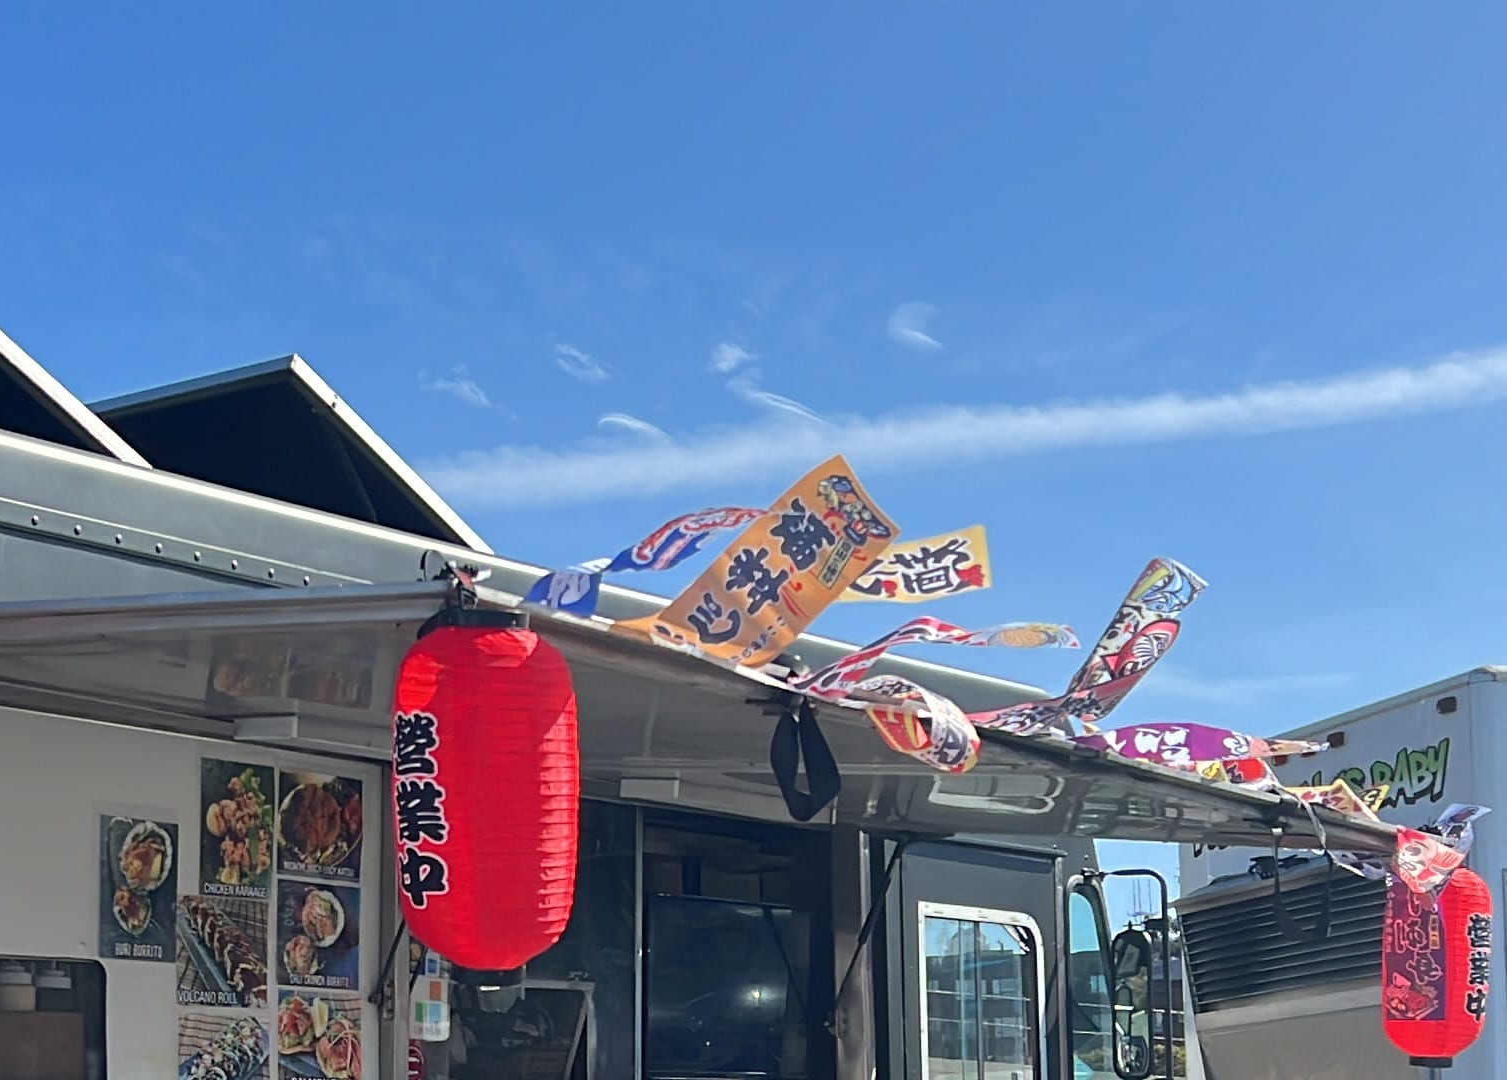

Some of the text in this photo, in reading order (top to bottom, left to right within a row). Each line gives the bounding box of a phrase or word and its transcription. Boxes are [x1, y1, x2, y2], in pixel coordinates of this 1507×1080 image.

[1372, 737, 1451, 808] BABY
[203, 882, 234, 895] CHICKEN
[133, 943, 163, 959] BURRITO
[177, 990, 239, 1006] VOLCANO ROLL
